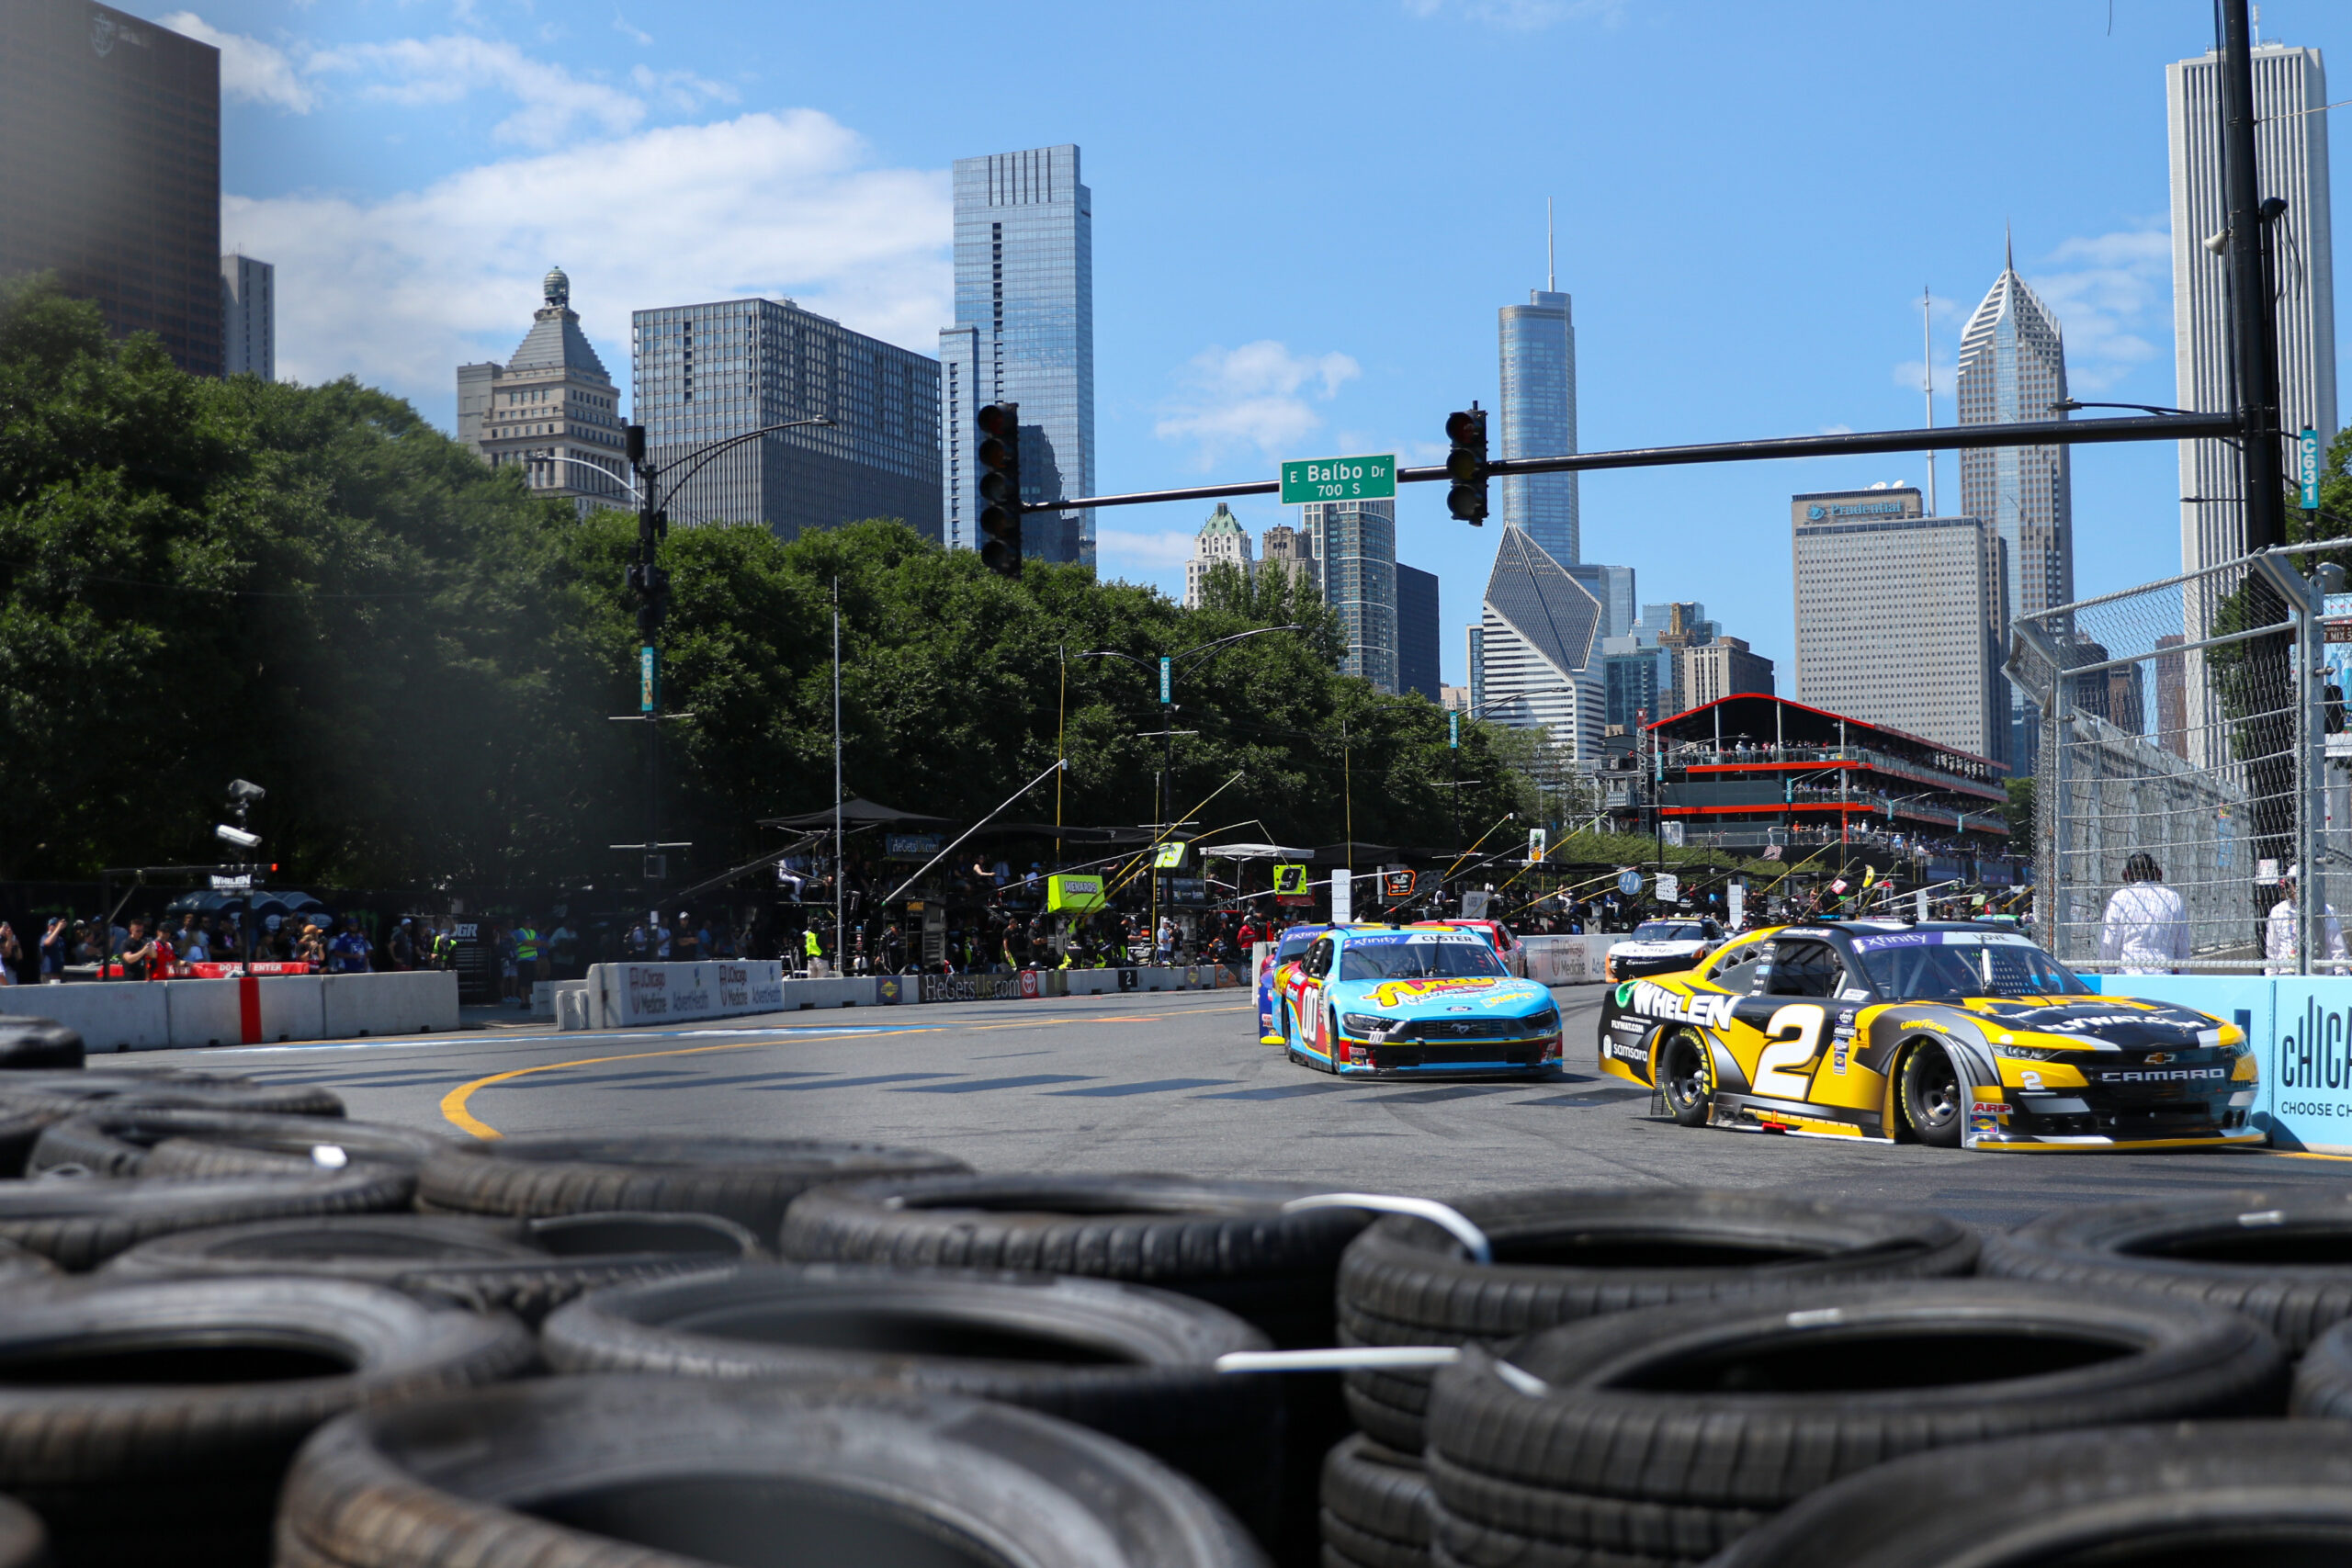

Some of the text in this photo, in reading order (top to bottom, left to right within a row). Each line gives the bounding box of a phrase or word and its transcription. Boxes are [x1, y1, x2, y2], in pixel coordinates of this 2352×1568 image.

[1290, 463, 1385, 483] E Balbo Dr
[2301, 438, 2316, 501] C631
[1317, 482, 1361, 497] 700 S
[1830, 499, 1902, 516] Prudential
[1161, 661, 1170, 698] C620
[1154, 842, 1186, 867] 19
[211, 874, 252, 885] WHELEN
[1065, 881, 1098, 893] MENARDS
[1279, 867, 1302, 893] 9
[1353, 935, 1398, 948] xfinity
[1421, 934, 1474, 942] CUSTER
[1865, 932, 1927, 948] xfinity
[219, 964, 232, 972] DO
[254, 964, 282, 972] ENTER
[1561, 957, 1586, 976] Medicine
[925, 972, 1022, 1000] HeGetsUs.com
[1125, 972, 1134, 986] 2
[641, 990, 667, 1013] Medicine
[728, 988, 748, 1006] Medicine
[1634, 980, 1746, 1032] WHELEN
[1302, 986, 1319, 1044] 00
[2037, 1015, 2207, 1032] FLYWAT.COM
[1611, 1019, 1645, 1034] FLYWAT.COM
[1899, 1018, 1950, 1034] GOODYEAR
[1368, 1031, 1386, 1044] 00
[1613, 1043, 1648, 1062] samsara
[1750, 1002, 1826, 1102] 2
[2020, 1070, 2046, 1091] 2
[2101, 1067, 2225, 1082] CAMARO
[1972, 1102, 2012, 1112] ARP
[2280, 1100, 2333, 1117] CHOOSE
